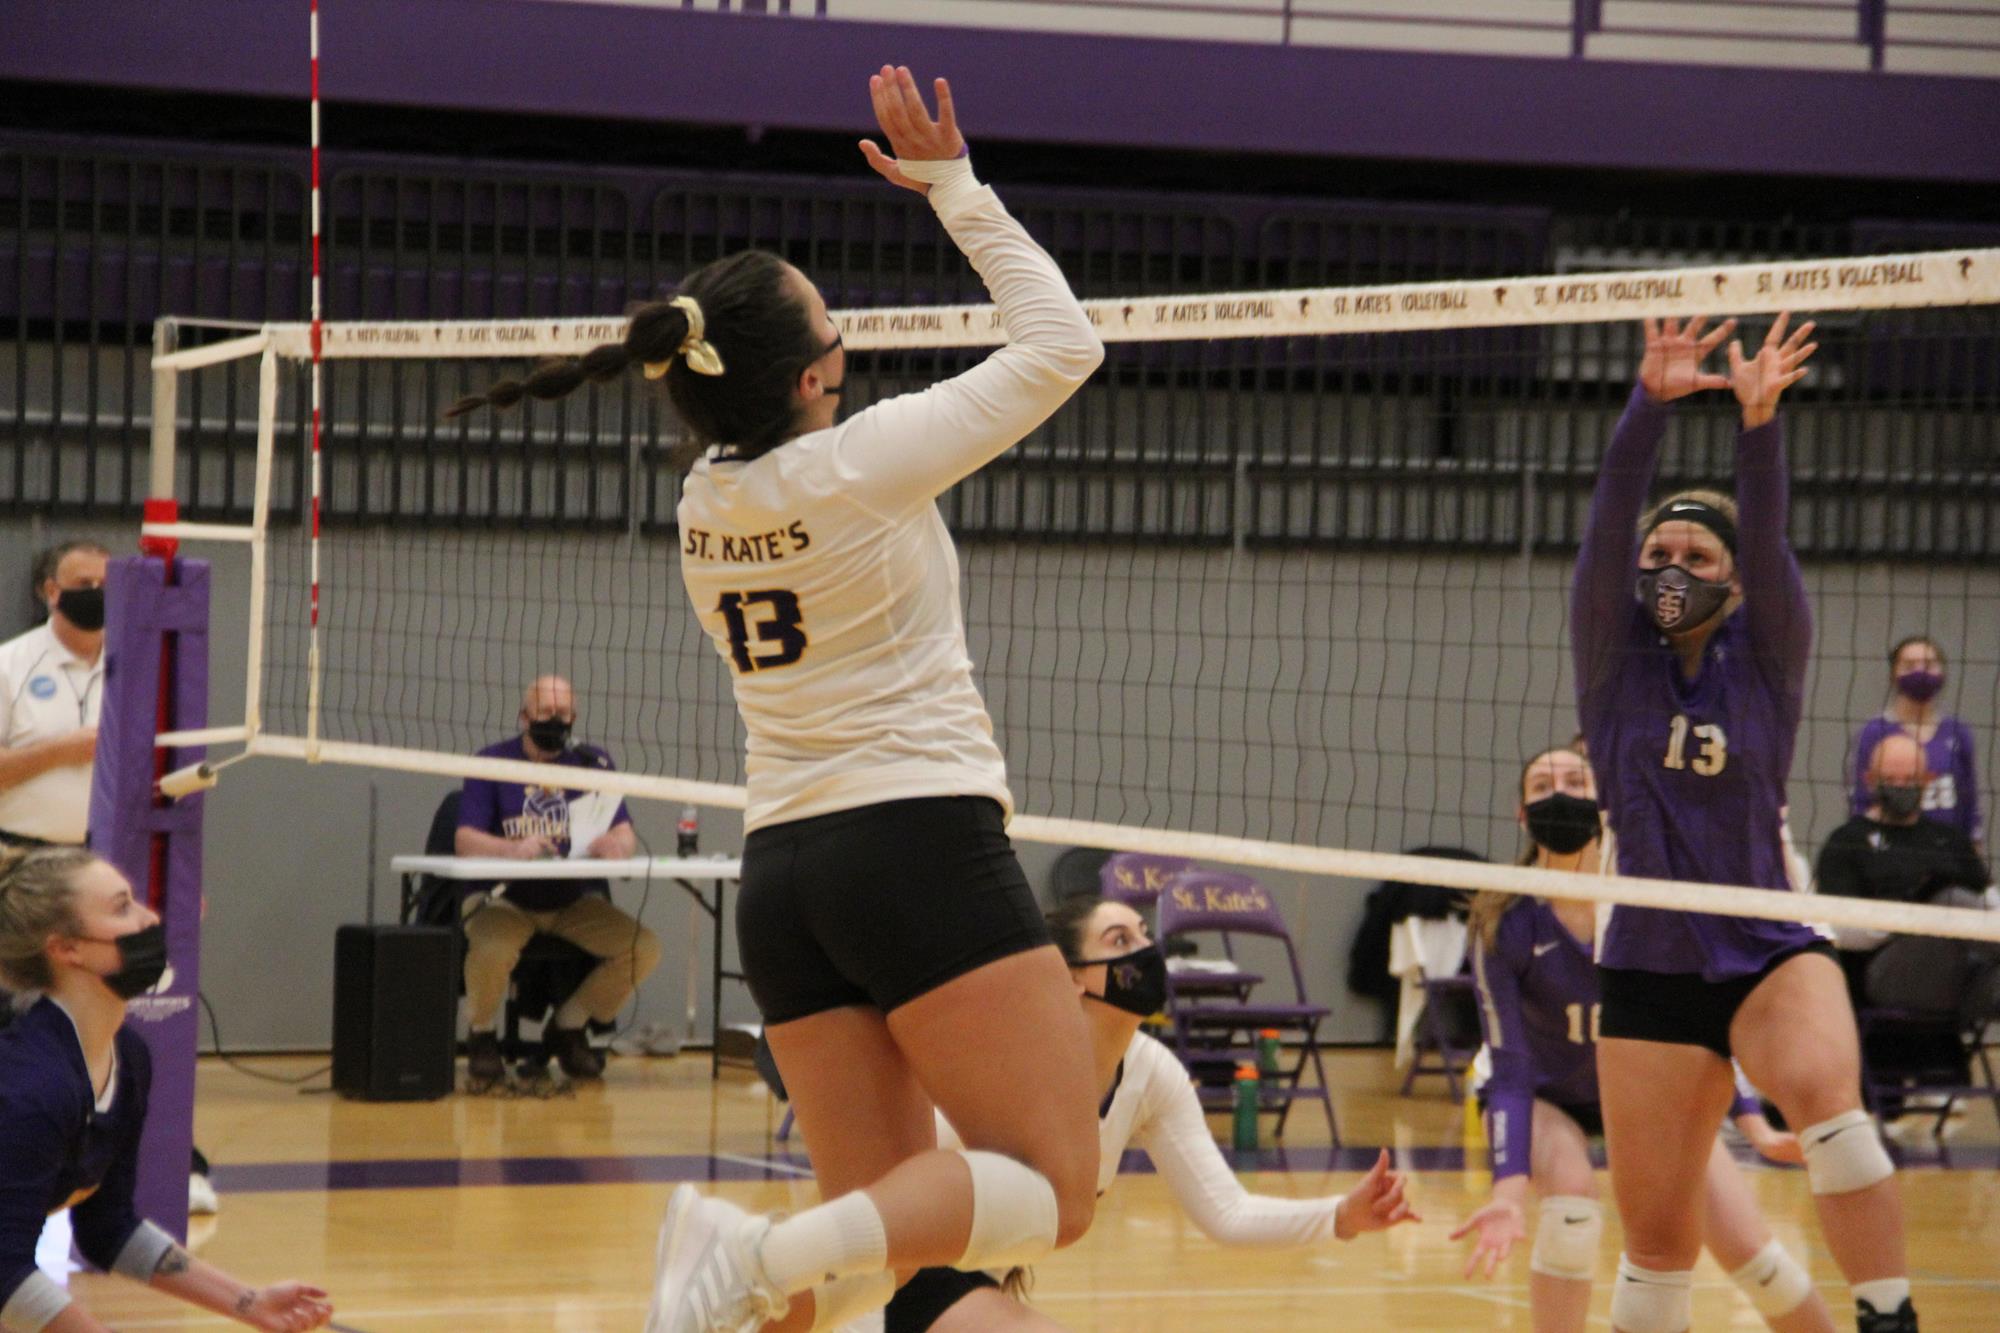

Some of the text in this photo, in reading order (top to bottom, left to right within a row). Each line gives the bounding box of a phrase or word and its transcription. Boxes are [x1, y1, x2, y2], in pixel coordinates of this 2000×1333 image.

[1838, 261, 1924, 287] VOLLEYBALL
[1606, 277, 1683, 300] VOLLEYBALL
[1172, 302, 1208, 322] KATE'S
[1214, 301, 1275, 321] VOLLEYBALL
[1354, 294, 1392, 315] KATE'S
[1401, 290, 1468, 313] VOLLEYBALL
[685, 519, 811, 562] ST. KATE'S
[714, 589, 808, 674] 13
[1663, 714, 1728, 776] 13
[1203, 885, 1268, 913] Kate's
